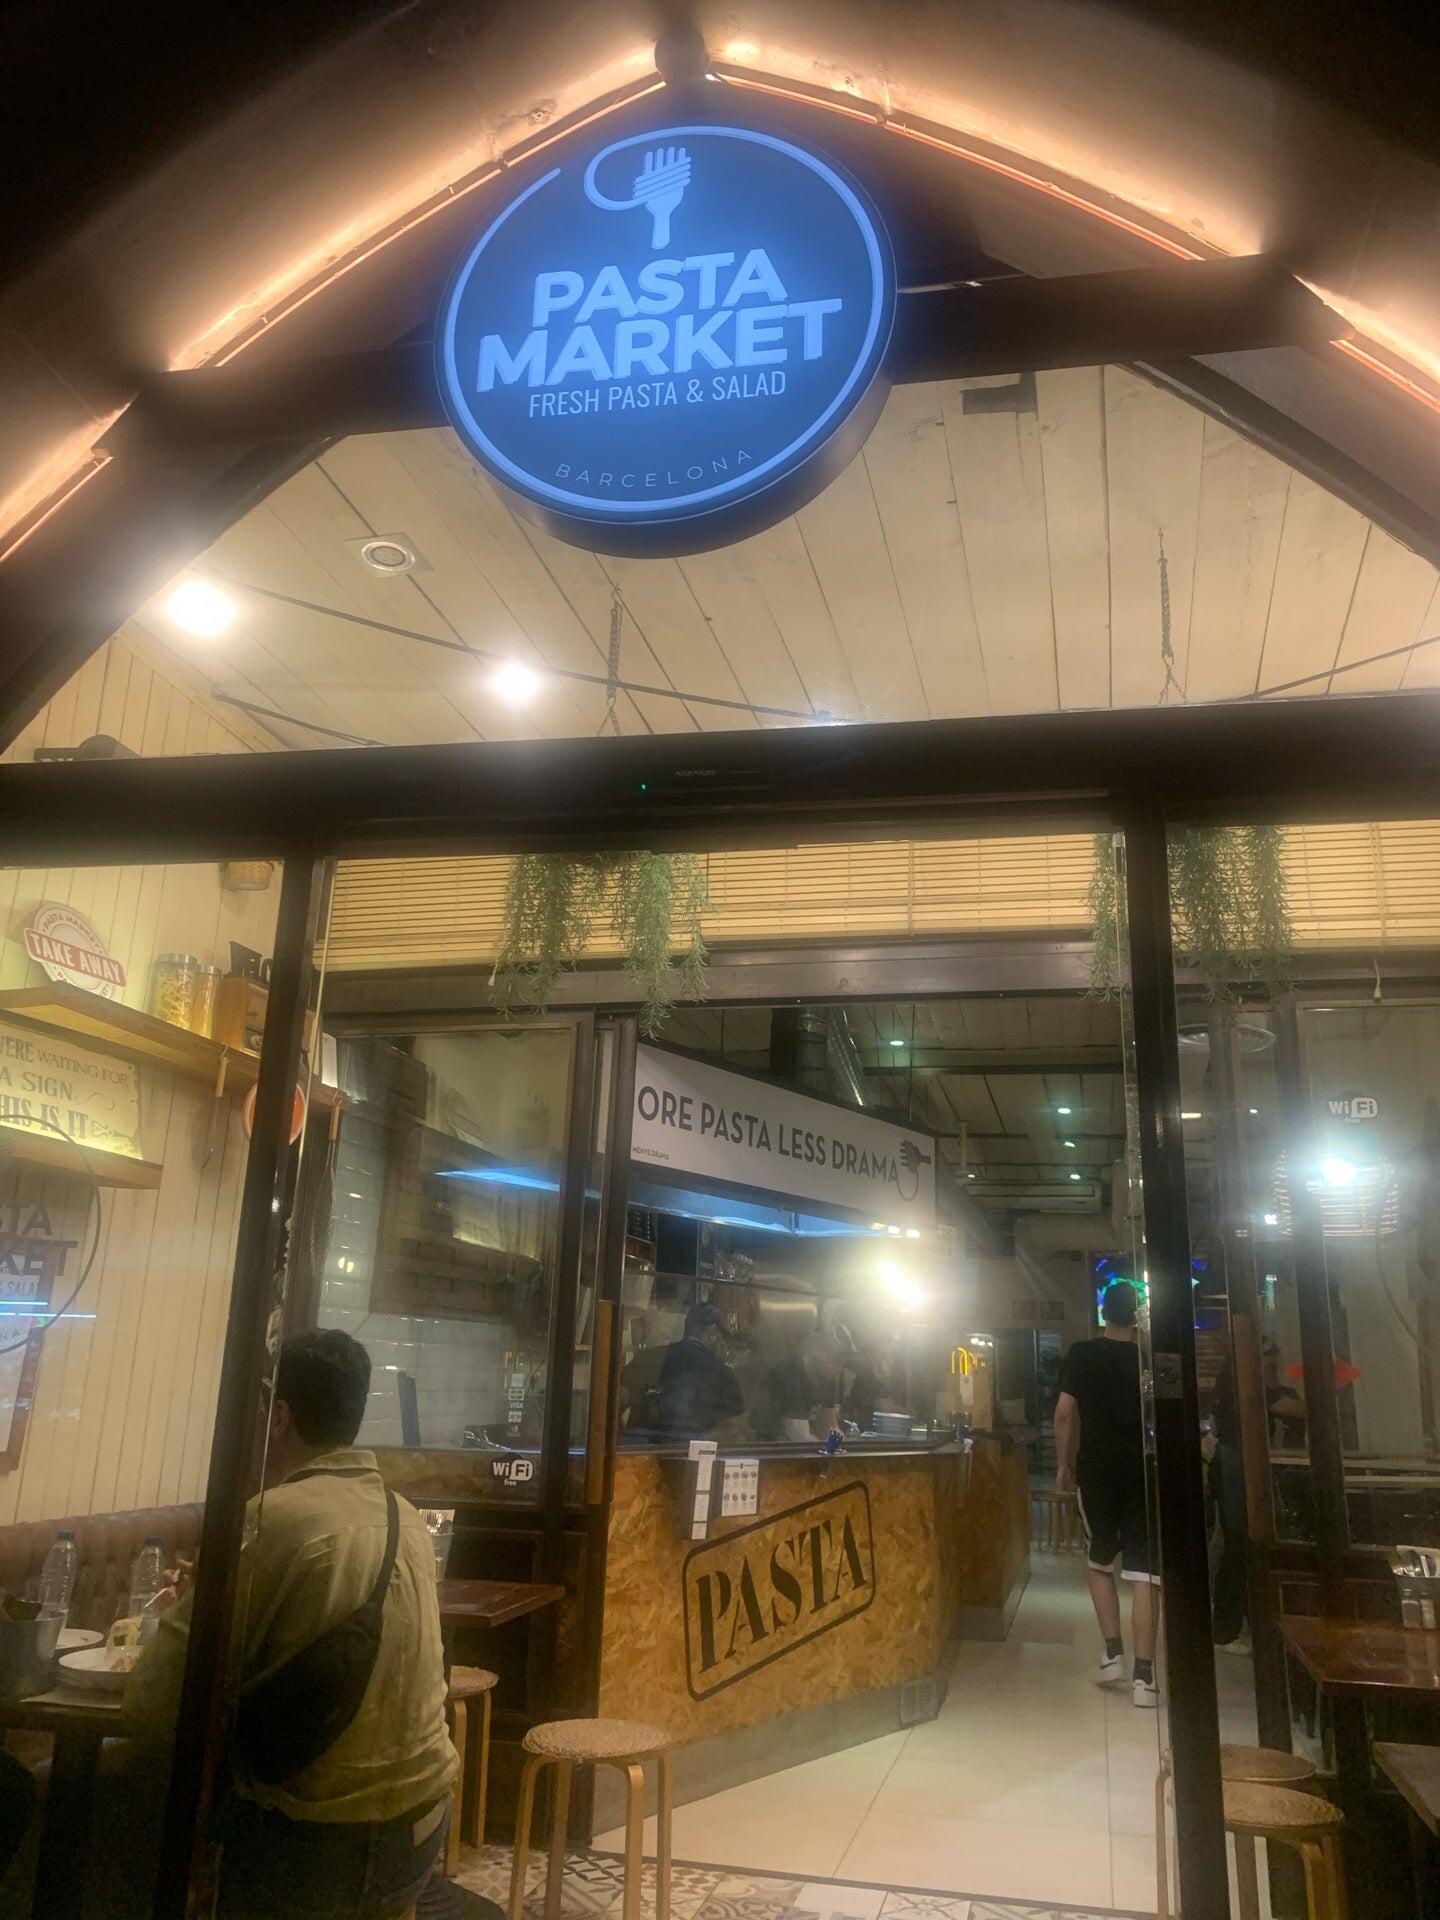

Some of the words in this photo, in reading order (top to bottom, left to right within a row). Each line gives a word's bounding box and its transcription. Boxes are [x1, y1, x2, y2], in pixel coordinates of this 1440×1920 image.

[533, 248, 788, 327] PASTA
[477, 299, 842, 392] MARKET
[529, 388, 599, 418] FRESH
[608, 380, 678, 410] PASTA
[687, 379, 704, 404] &
[712, 371, 786, 401] SALAD
[555, 449, 752, 487] BARCELONA
[29, 933, 76, 967] TAKE
[80, 952, 122, 983] AWAY
[0, 1066, 12, 1087] A
[22, 1071, 72, 1101] SIGN
[38, 1050, 98, 1078] WAITING
[102, 1067, 129, 1088] FOR
[40, 1103, 60, 1132] IS
[67, 1110, 88, 1139] IT
[1328, 1098, 1378, 1118] WiFi
[638, 1085, 693, 1130] ORE
[700, 1103, 772, 1152] PASTA
[779, 1124, 826, 1166] LESS
[832, 1140, 898, 1183] DRAMA
[493, 1460, 533, 1480] WiFi
[695, 1513, 868, 1673] PASTA
